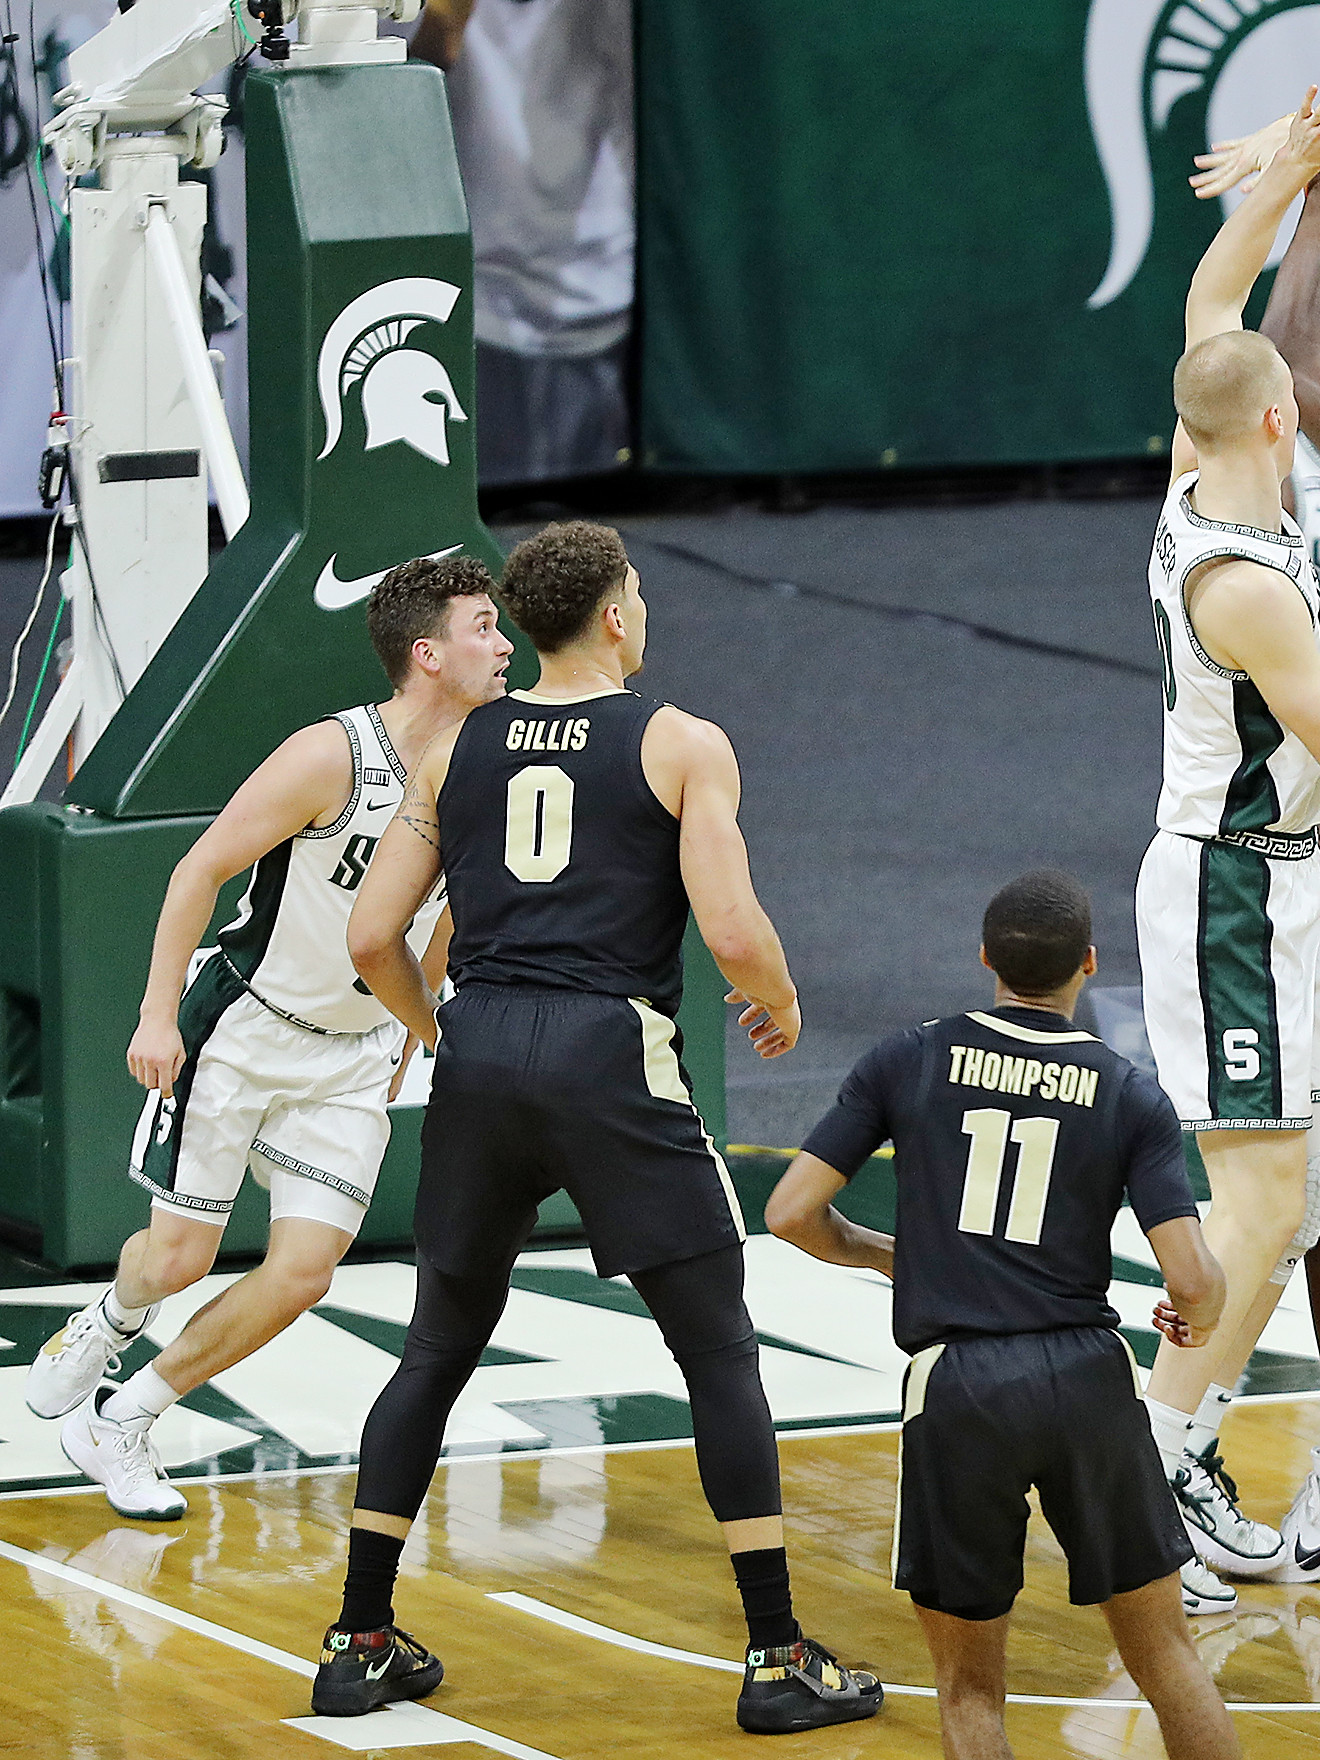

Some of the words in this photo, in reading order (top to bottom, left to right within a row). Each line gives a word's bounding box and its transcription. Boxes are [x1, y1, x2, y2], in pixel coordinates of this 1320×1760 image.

[505, 718, 591, 752] GILLIS
[363, 767, 391, 787] UNITY
[503, 764, 576, 884] 0
[948, 1045, 1100, 1109] THOMPSON
[1222, 1027, 1262, 1081] S
[957, 1107, 1061, 1246] 11
